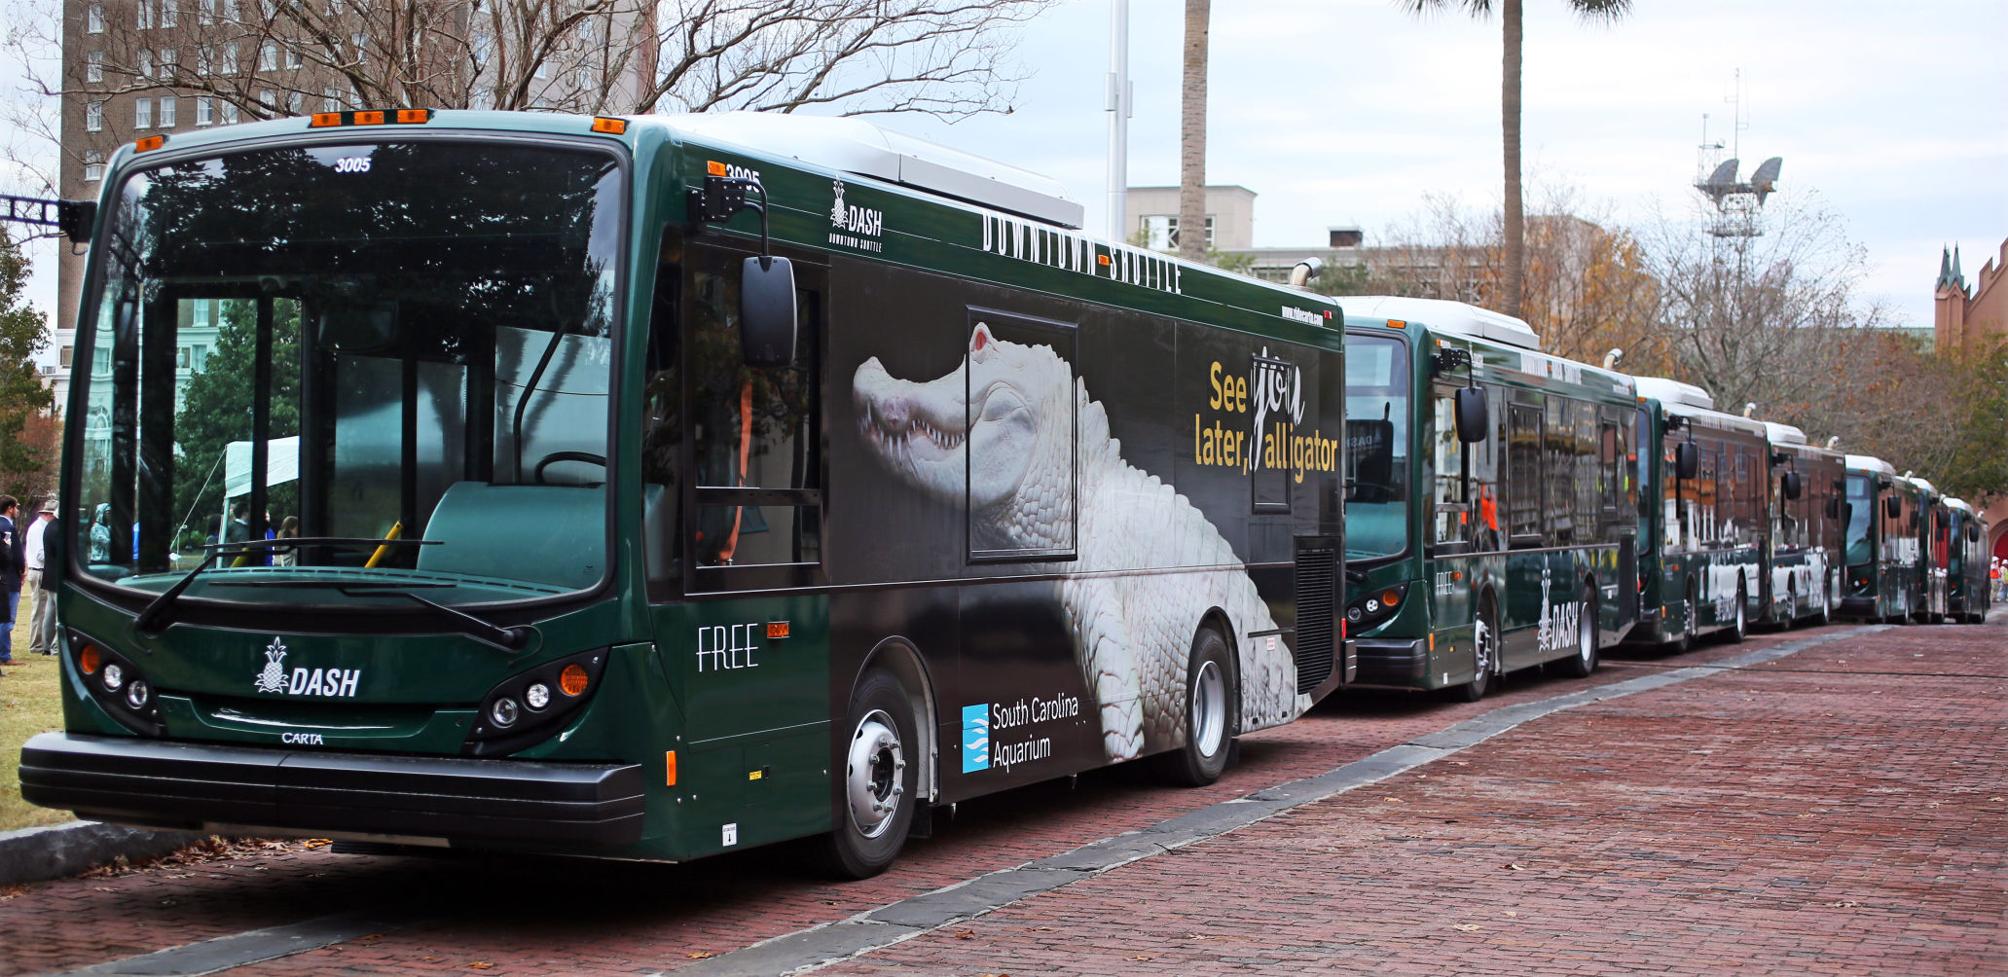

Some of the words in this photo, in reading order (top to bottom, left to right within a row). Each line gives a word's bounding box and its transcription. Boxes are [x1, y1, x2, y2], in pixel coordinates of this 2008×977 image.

[335, 157, 372, 173] 3005
[848, 205, 882, 237] DASH
[829, 232, 858, 248] DOWNTOWN
[860, 238, 882, 253] SHUTTLE
[982, 211, 1096, 275] DOWNTOWN
[1109, 242, 1182, 295] SHUTTLE
[1210, 361, 1247, 413] See
[1250, 345, 1306, 473] you
[1195, 412, 1249, 476] later,
[1264, 421, 1338, 484] alligator
[1551, 601, 1578, 651] DASH
[696, 623, 759, 673] FREE
[288, 667, 361, 697] DASH
[993, 698, 1029, 730] South
[1032, 692, 1079, 723] Carolina
[281, 732, 324, 745] CARTA
[993, 734, 1051, 774] Aquarium
